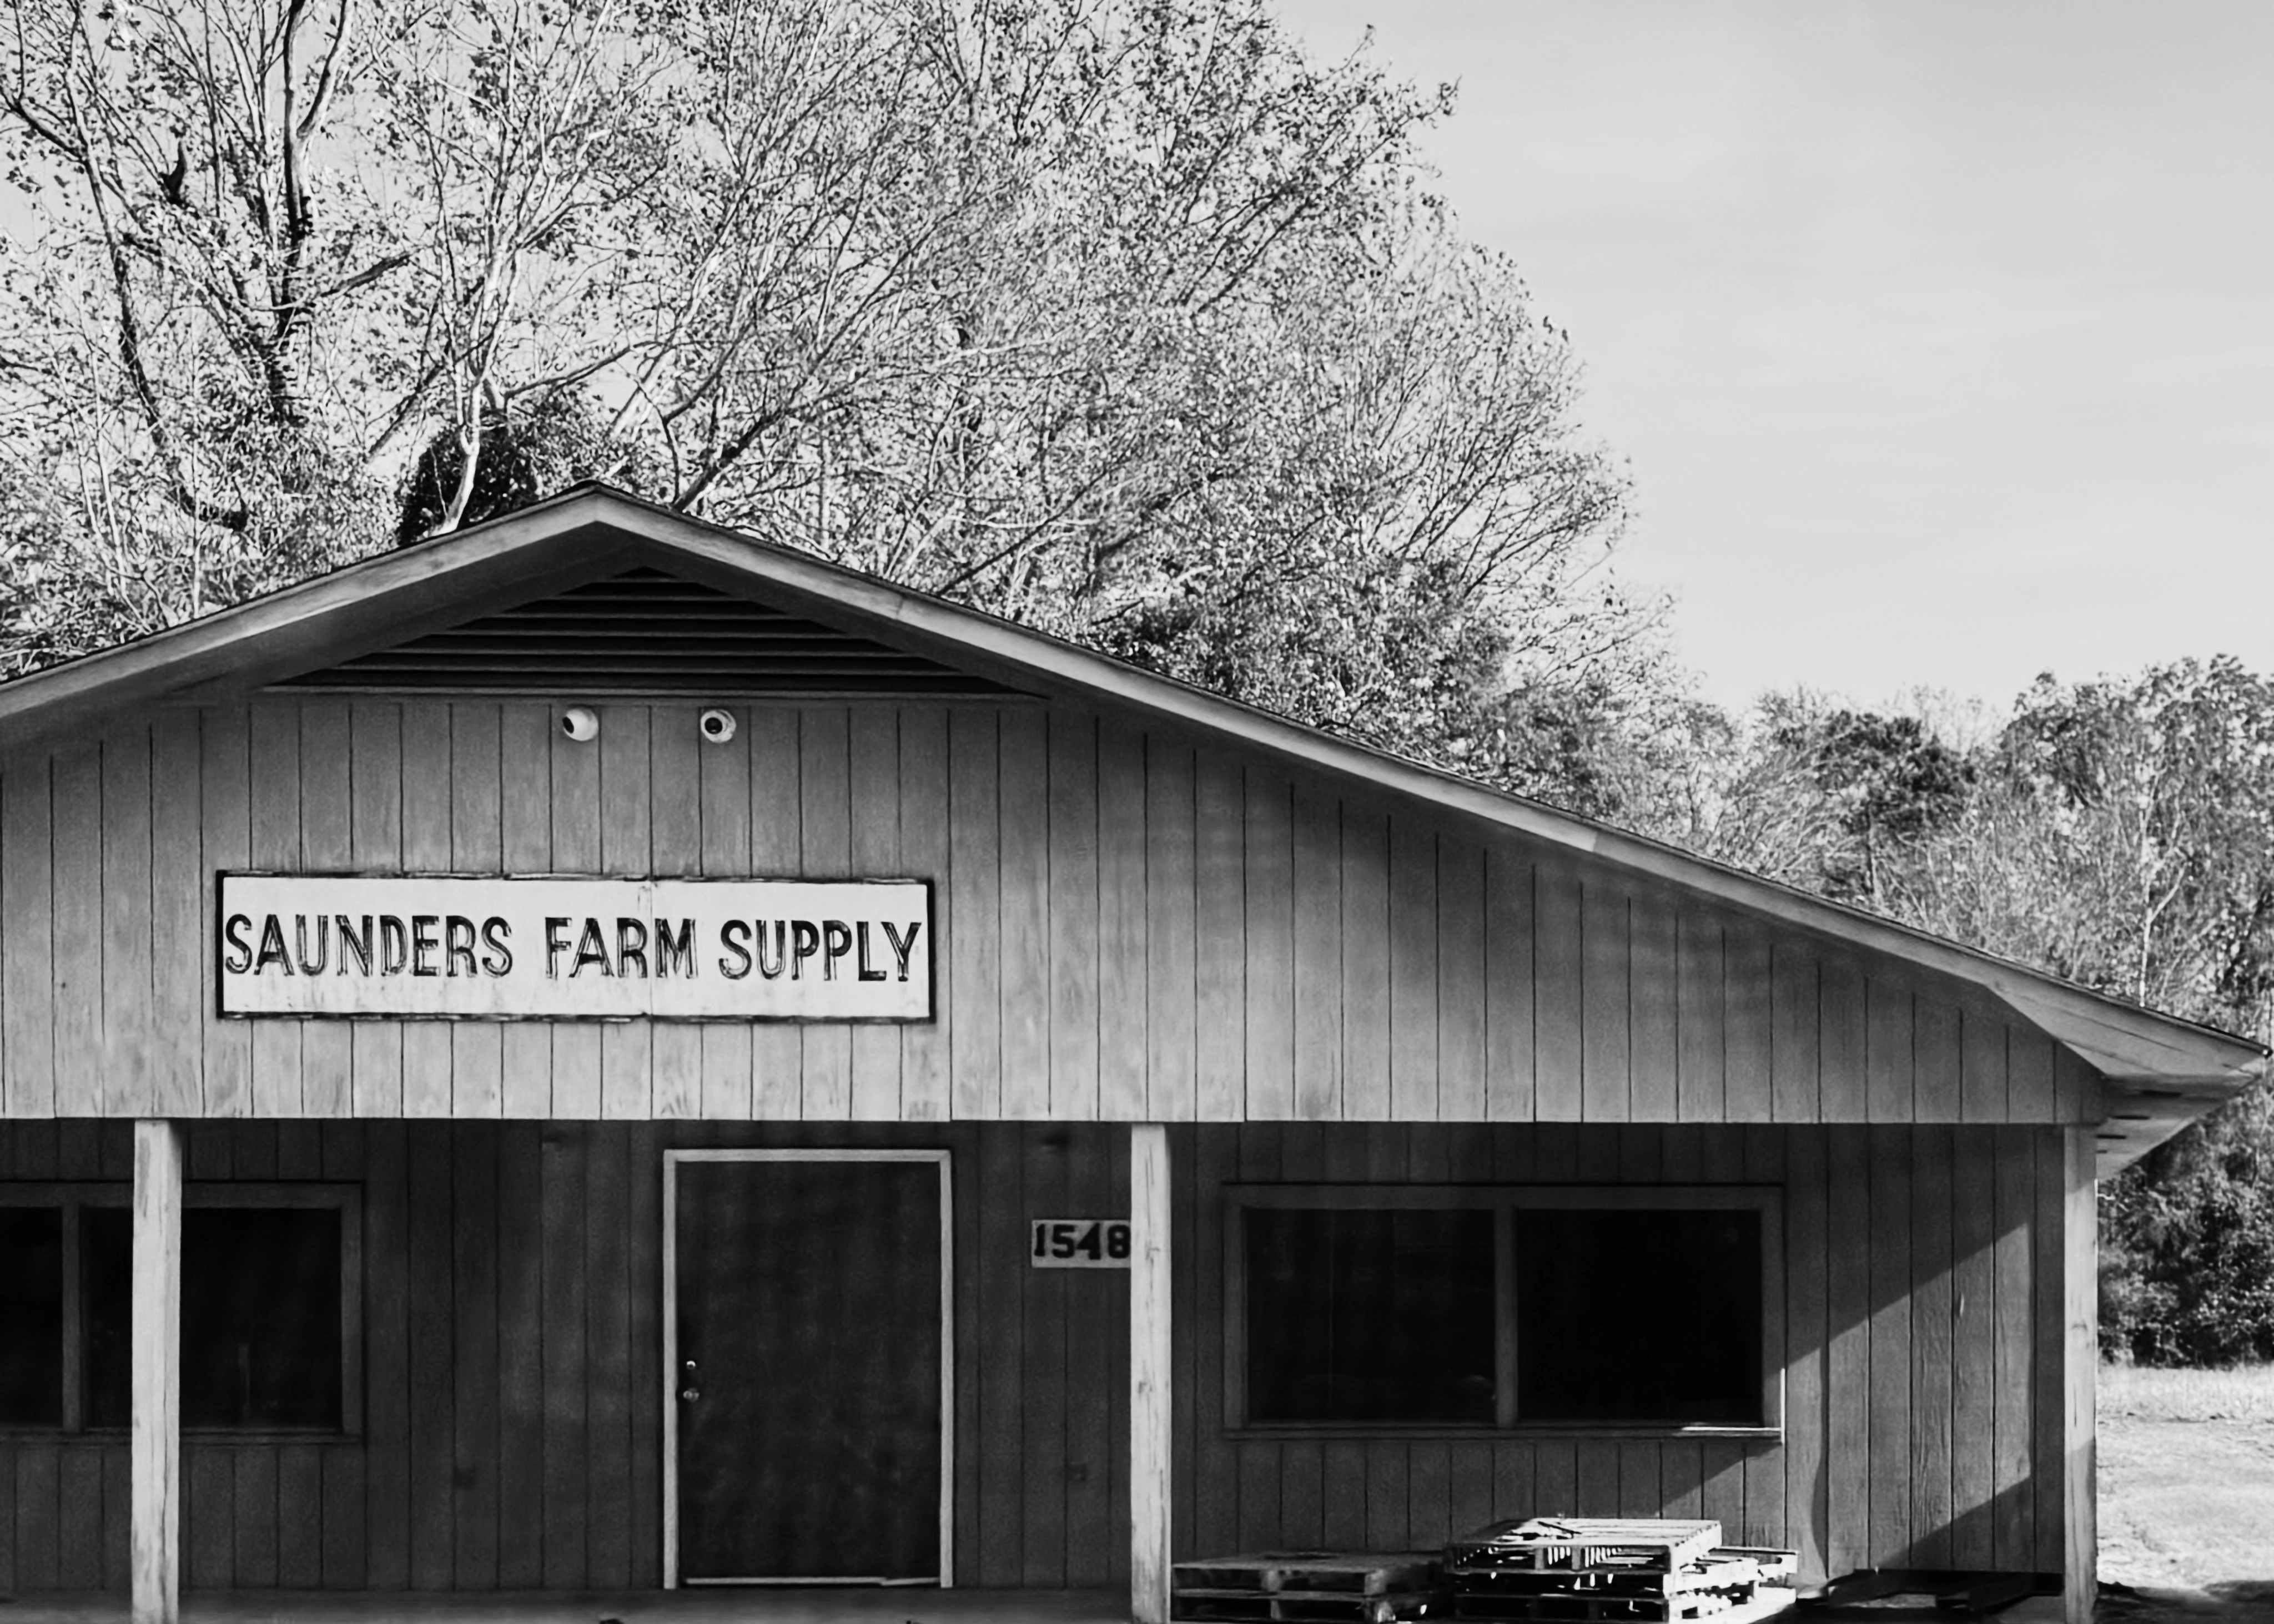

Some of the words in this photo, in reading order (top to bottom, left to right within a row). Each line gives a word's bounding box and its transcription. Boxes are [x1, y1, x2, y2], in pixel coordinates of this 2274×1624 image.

[224, 913, 513, 979] SAUNDERS
[545, 916, 699, 980] FARM
[718, 917, 922, 982] SUPPLY
[1034, 1223, 1131, 1260] 1548
